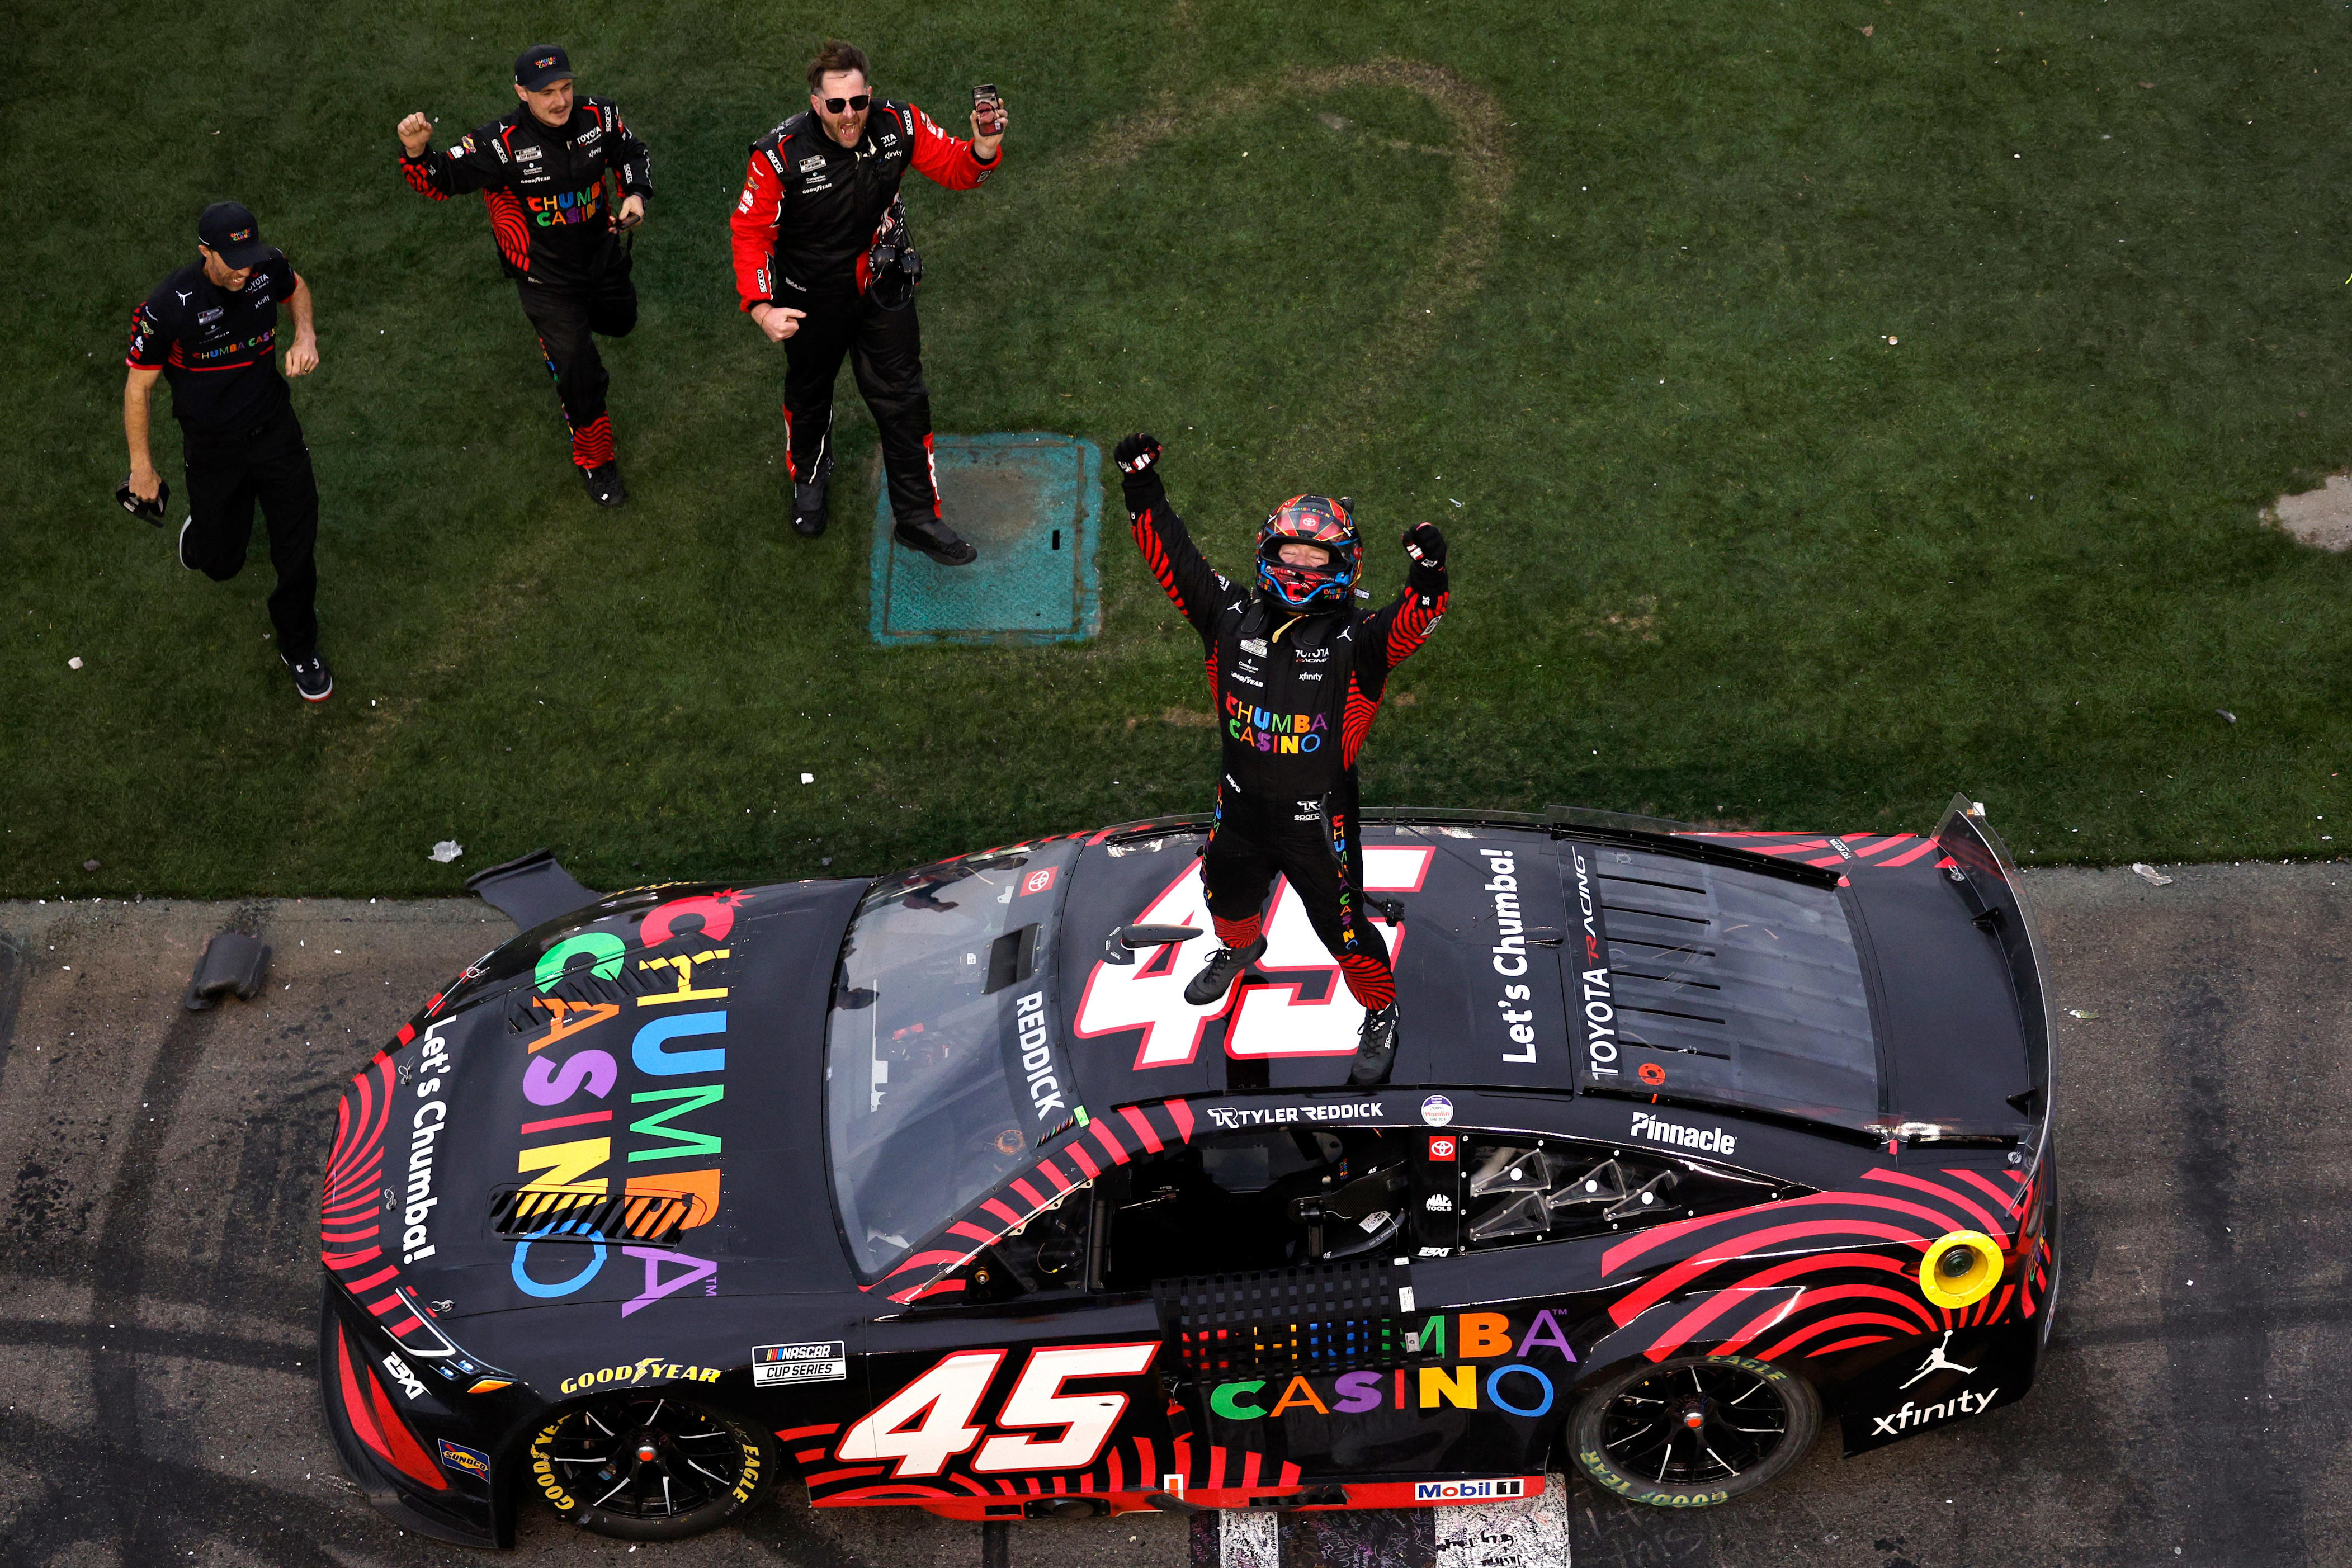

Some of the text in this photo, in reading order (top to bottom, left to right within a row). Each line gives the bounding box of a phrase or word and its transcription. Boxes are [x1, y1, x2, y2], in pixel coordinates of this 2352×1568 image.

[604, 106, 612, 132] sparco
[903, 110, 913, 135] sparco
[491, 138, 508, 164] sparco
[766, 149, 783, 174] sparco
[521, 176, 550, 184] GOODYEAR
[802, 183, 832, 195] GOODYEAR
[526, 181, 601, 212] CHUMB
[757, 268, 768, 293] sparco
[1298, 672, 1323, 682] xfinity
[1225, 691, 1328, 734] CHUMBA
[1229, 718, 1321, 754] CASINO
[1293, 813, 1321, 821] sparc
[1829, 839, 1852, 860] TOYOTA
[1480, 848, 1529, 977] Chumba!
[1572, 846, 1601, 967] RACING
[1073, 845, 1437, 1071] 45
[1384, 1019, 1396, 1049] sparco
[1498, 984, 1537, 1064] Let's
[1582, 967, 1620, 1080] TOYOTA
[1016, 990, 1065, 1121] REDDICK
[511, 932, 626, 1298] CASINO
[621, 887, 747, 1319] CHUMBA
[1238, 1107, 1299, 1125] TYLER
[1300, 1102, 1384, 1120] REDDICK
[403, 1014, 457, 1265] Let's Chumba!
[1630, 1111, 1737, 1156] Pinnacle
[1368, 1166, 1377, 1174] 45
[1425, 1194, 1452, 1206] MAC
[781, 1345, 831, 1360] NASCAR
[560, 1358, 721, 1395] GOODYEAR
[767, 1363, 833, 1378] CUP SERIES
[1706, 1354, 1787, 1382] EAGLE
[1211, 1364, 1554, 1420] CASINO
[834, 1340, 1163, 1479] 45
[1871, 1387, 1999, 1436] xfinity
[445, 1451, 487, 1471] SUNOCO
[731, 1443, 761, 1504] EAGLE
[1419, 1482, 1490, 1499] Mobil
